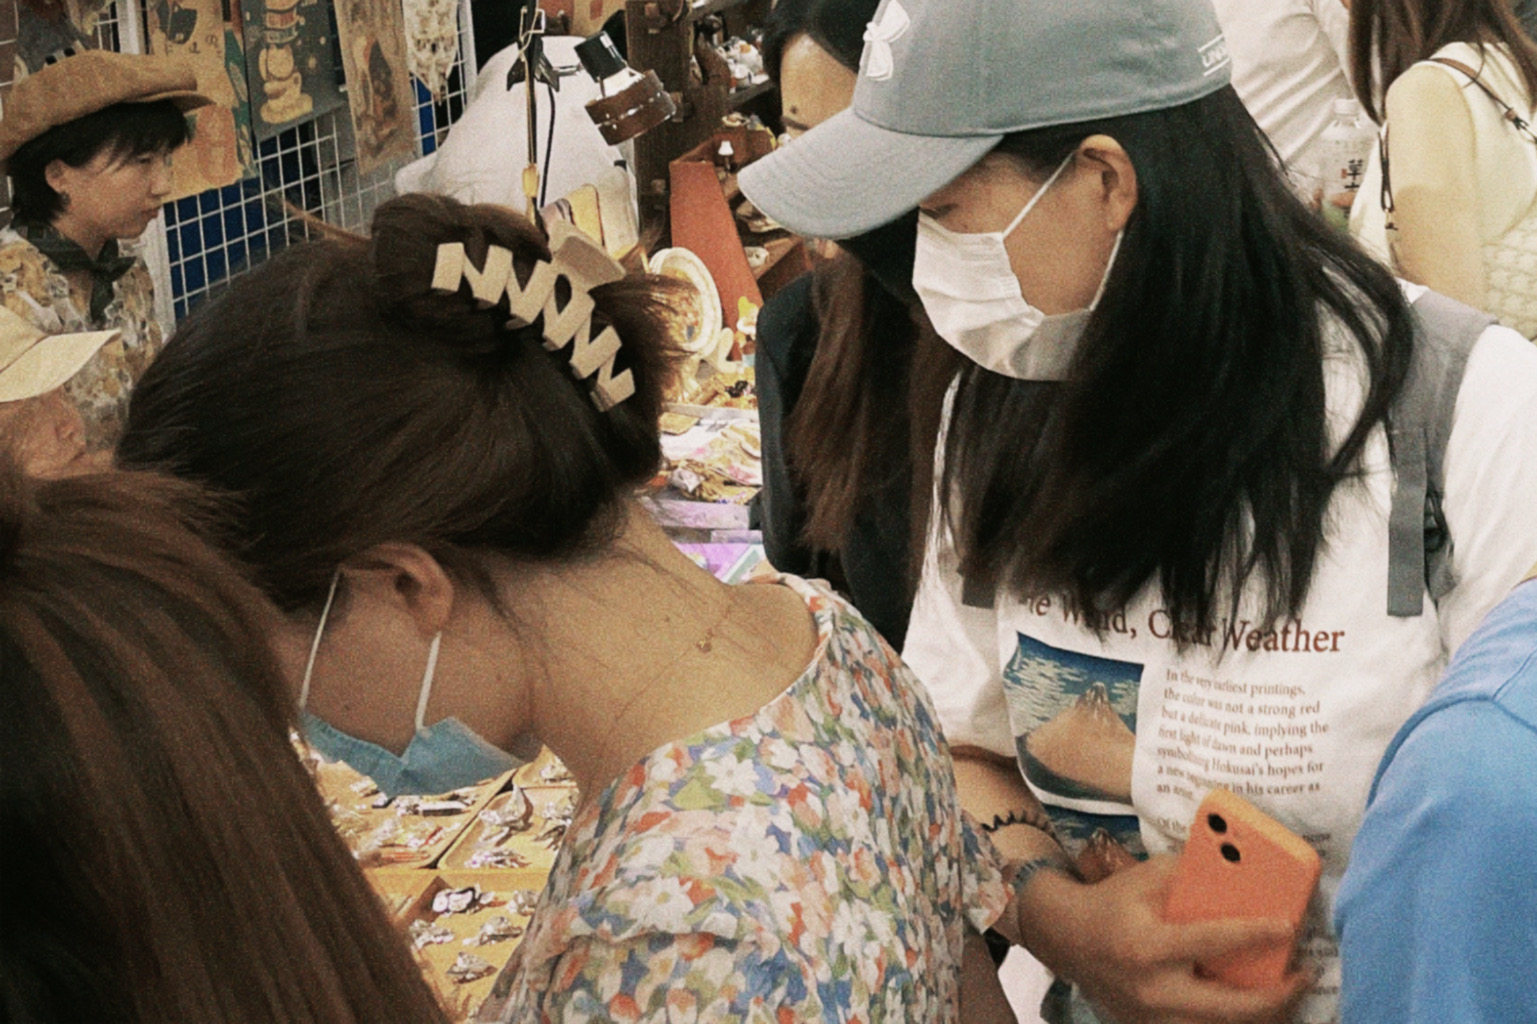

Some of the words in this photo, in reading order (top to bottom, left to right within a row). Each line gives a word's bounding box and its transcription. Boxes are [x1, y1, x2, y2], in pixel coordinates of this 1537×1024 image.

[1222, 616, 1346, 653] Weather
[1181, 671, 1194, 683] the
[1164, 688, 1180, 700] the
[1225, 701, 1243, 714] not
[1258, 704, 1296, 718] strong
[1300, 700, 1320, 713] red
[1162, 705, 1177, 719] but
[1254, 724, 1307, 740] implying
[1310, 720, 1329, 734] the
[1240, 743, 1261, 756] and
[1264, 744, 1313, 759] perhaps
[1268, 762, 1303, 779] hopes
[1307, 760, 1323, 773] for
[1157, 784, 1171, 794] an
[1232, 781, 1243, 793] in
[1246, 781, 1264, 795] his
[1267, 784, 1304, 795] career
[1308, 782, 1320, 792] as
